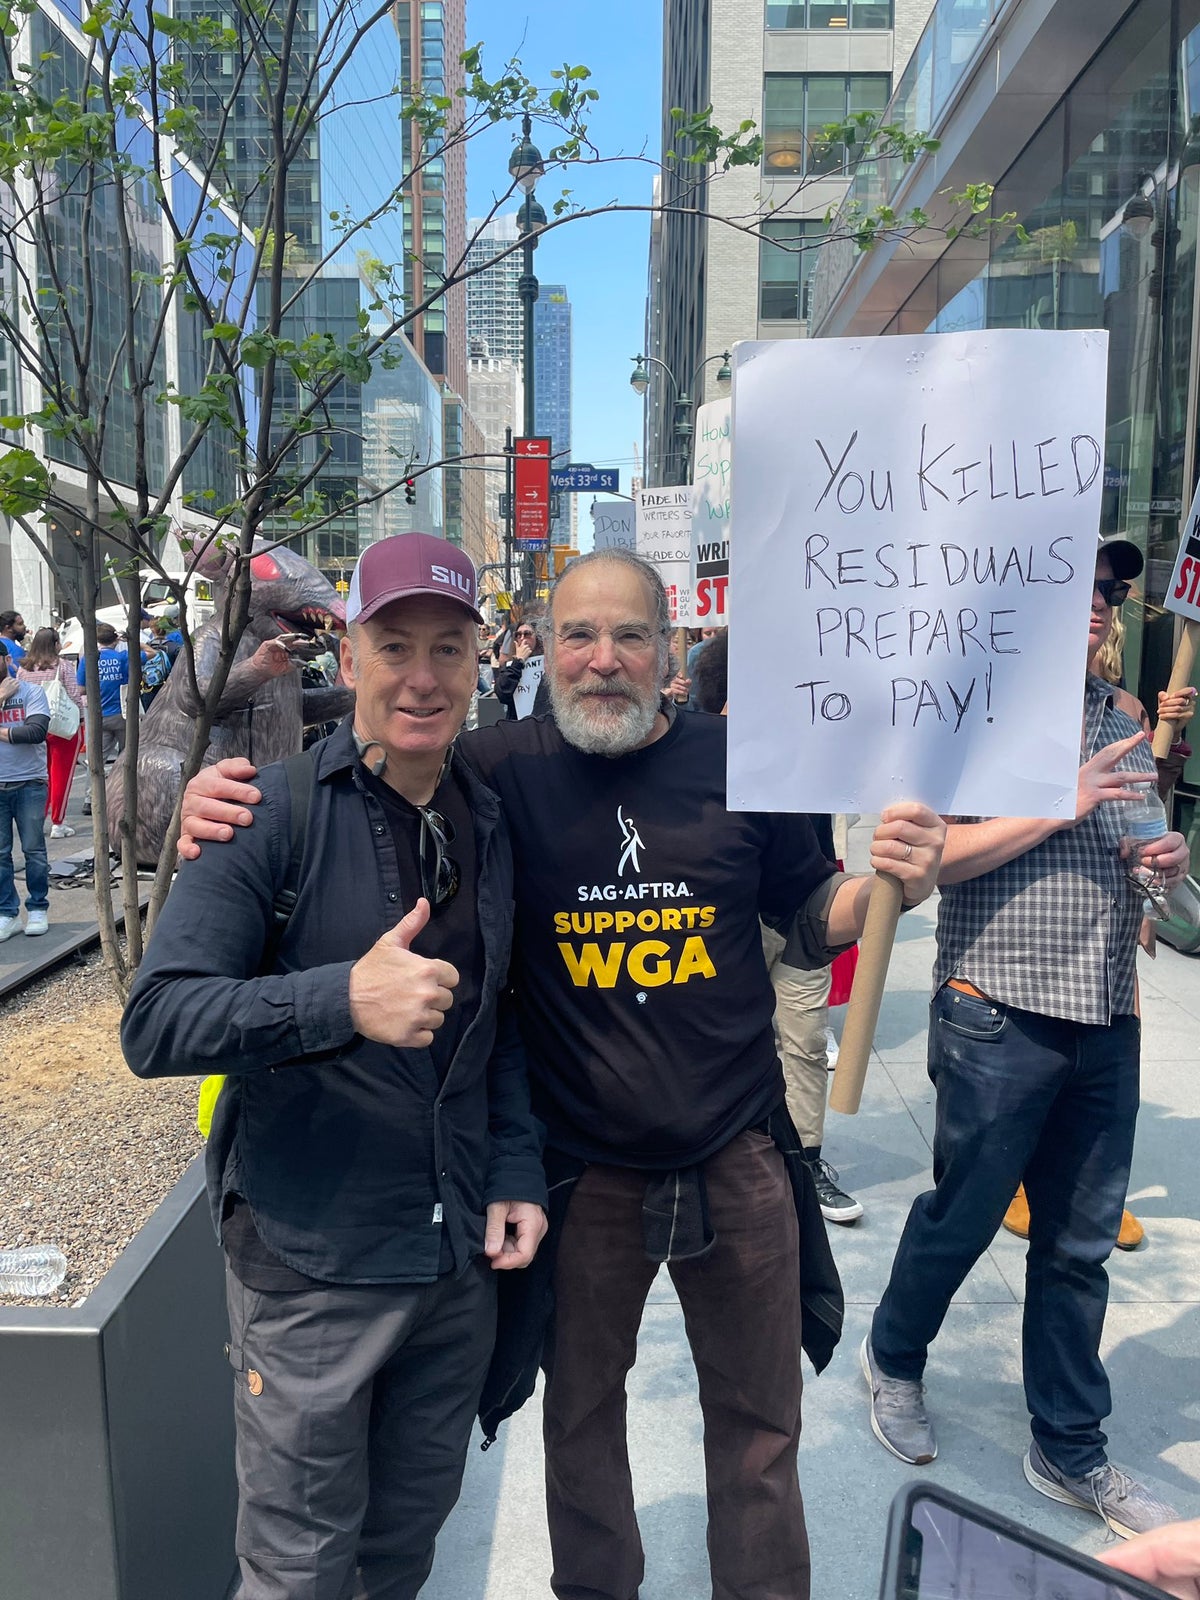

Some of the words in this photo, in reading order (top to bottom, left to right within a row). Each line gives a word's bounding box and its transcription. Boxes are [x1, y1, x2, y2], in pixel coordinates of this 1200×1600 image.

[577, 474, 598, 487] 33rd
[600, 474, 613, 487] St
[917, 424, 1101, 511] KILLED
[641, 493, 671, 507] FADE
[643, 511, 680, 521] WRITERS
[646, 550, 673, 560] FADE
[804, 534, 1076, 590] RESIDUALS
[431, 565, 471, 596] SIU
[816, 607, 1021, 659] PREPARE
[891, 662, 995, 733] PAY!
[553, 905, 717, 935] SUPPORTS
[557, 935, 717, 989] WGA
